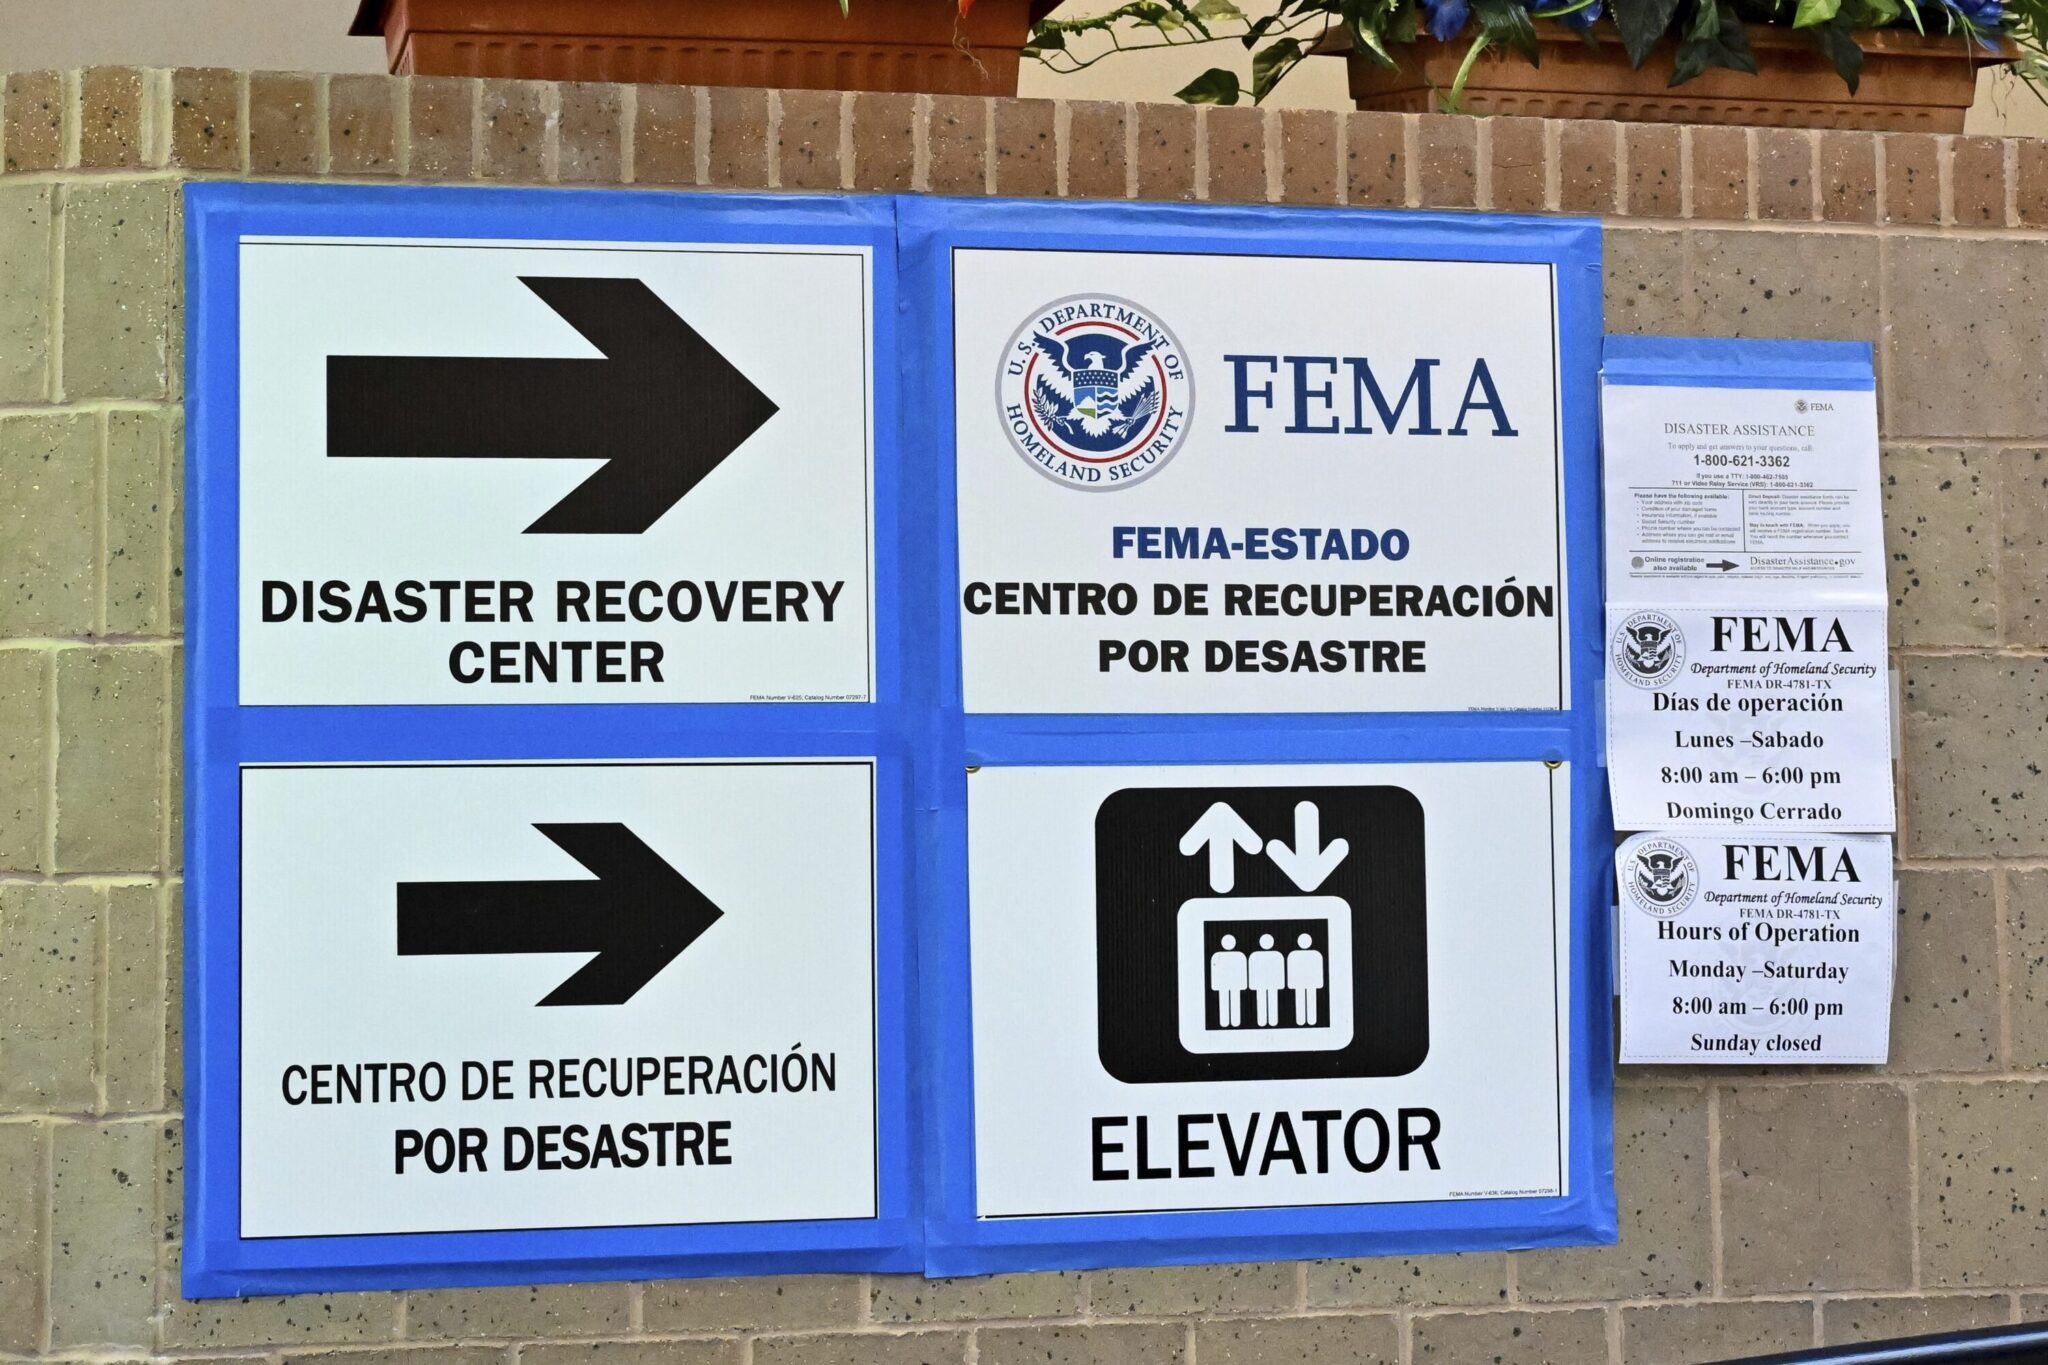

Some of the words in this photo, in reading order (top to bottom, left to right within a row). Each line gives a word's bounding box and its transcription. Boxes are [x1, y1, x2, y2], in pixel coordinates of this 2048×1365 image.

[1007, 341, 1036, 376] U.S.
[1038, 303, 1170, 351] DEPARTMENT
[1164, 354, 1184, 381] OF
[1224, 355, 1518, 436] FEMA
[1810, 403, 1834, 411] FEMA
[1006, 403, 1101, 482] HOMELAND
[1109, 405, 1183, 481] SECURITY
[1664, 423, 1729, 435] DISASTER
[1733, 425, 1815, 436] ASSISTANCE
[1694, 454, 1790, 467] 1-800-621-3362
[1112, 526, 1410, 561] FEMA-ESTADO
[262, 580, 533, 623] DISASTER
[557, 580, 845, 623] RECOVERY
[963, 581, 1138, 616] CENTRO
[1154, 582, 1208, 616] DE
[1224, 576, 1553, 617] RECUPERACIÓN
[1627, 614, 1677, 633] DEPARTMENT
[1675, 635, 1681, 643] OF
[1710, 616, 1854, 652] FEMA
[448, 641, 664, 683] CENTER
[1099, 640, 1189, 673] POR
[1205, 640, 1426, 673] DESASTRE
[1615, 653, 1651, 686] HOMELAND
[1654, 654, 1682, 685] SECURITY
[1690, 662, 1756, 678] Department
[1759, 662, 1773, 678] of
[1772, 662, 1829, 675] Homeland
[1831, 663, 1877, 678] Security
[1727, 679, 1762, 689] FEMA
[1765, 679, 1832, 690] DR-4781-TX
[1653, 691, 1699, 712] Días
[1706, 692, 1731, 712] de
[1738, 692, 1844, 717] operación
[1674, 730, 1734, 748] Lunes
[1660, 766, 1702, 784] 8:00
[1710, 770, 1738, 784] am
[1762, 767, 1804, 784] 6:00
[1810, 770, 1841, 788] pm
[1666, 801, 1754, 823] Domingo
[1760, 802, 1842, 820] Cerrado
[1638, 842, 1689, 861] DEPARTMENT
[1687, 862, 1695, 872] OF
[1721, 844, 1862, 882] FEMA
[1628, 881, 1665, 914] HOMELAND
[1667, 883, 1695, 914] SECURITY
[1704, 891, 1769, 907] Department
[1771, 892, 1783, 907] of
[1783, 892, 1838, 905] Homeland
[1841, 893, 1882, 909] Security
[1739, 908, 1773, 919] FEMA
[1776, 909, 1841, 920] DR-4781-TX
[1657, 920, 1722, 941] Hours
[1728, 921, 1750, 941] of
[1755, 922, 1860, 947] Operation
[1669, 959, 1746, 983] Monday
[1672, 996, 1713, 1015] 8:00
[1718, 1000, 1746, 1015] am
[1769, 997, 1809, 1015] 6:00
[1814, 1001, 1844, 1020] pm
[1690, 1033, 1760, 1055] Sunday
[1766, 1034, 1822, 1052] closed
[282, 1062, 446, 1105] CENTRO
[462, 1060, 514, 1100] DE
[529, 1043, 836, 1099] RECUPERACIÓN
[395, 1127, 488, 1174] POR
[504, 1120, 732, 1171] DESASTRE
[1092, 1107, 1441, 1181] ELEVATOR
